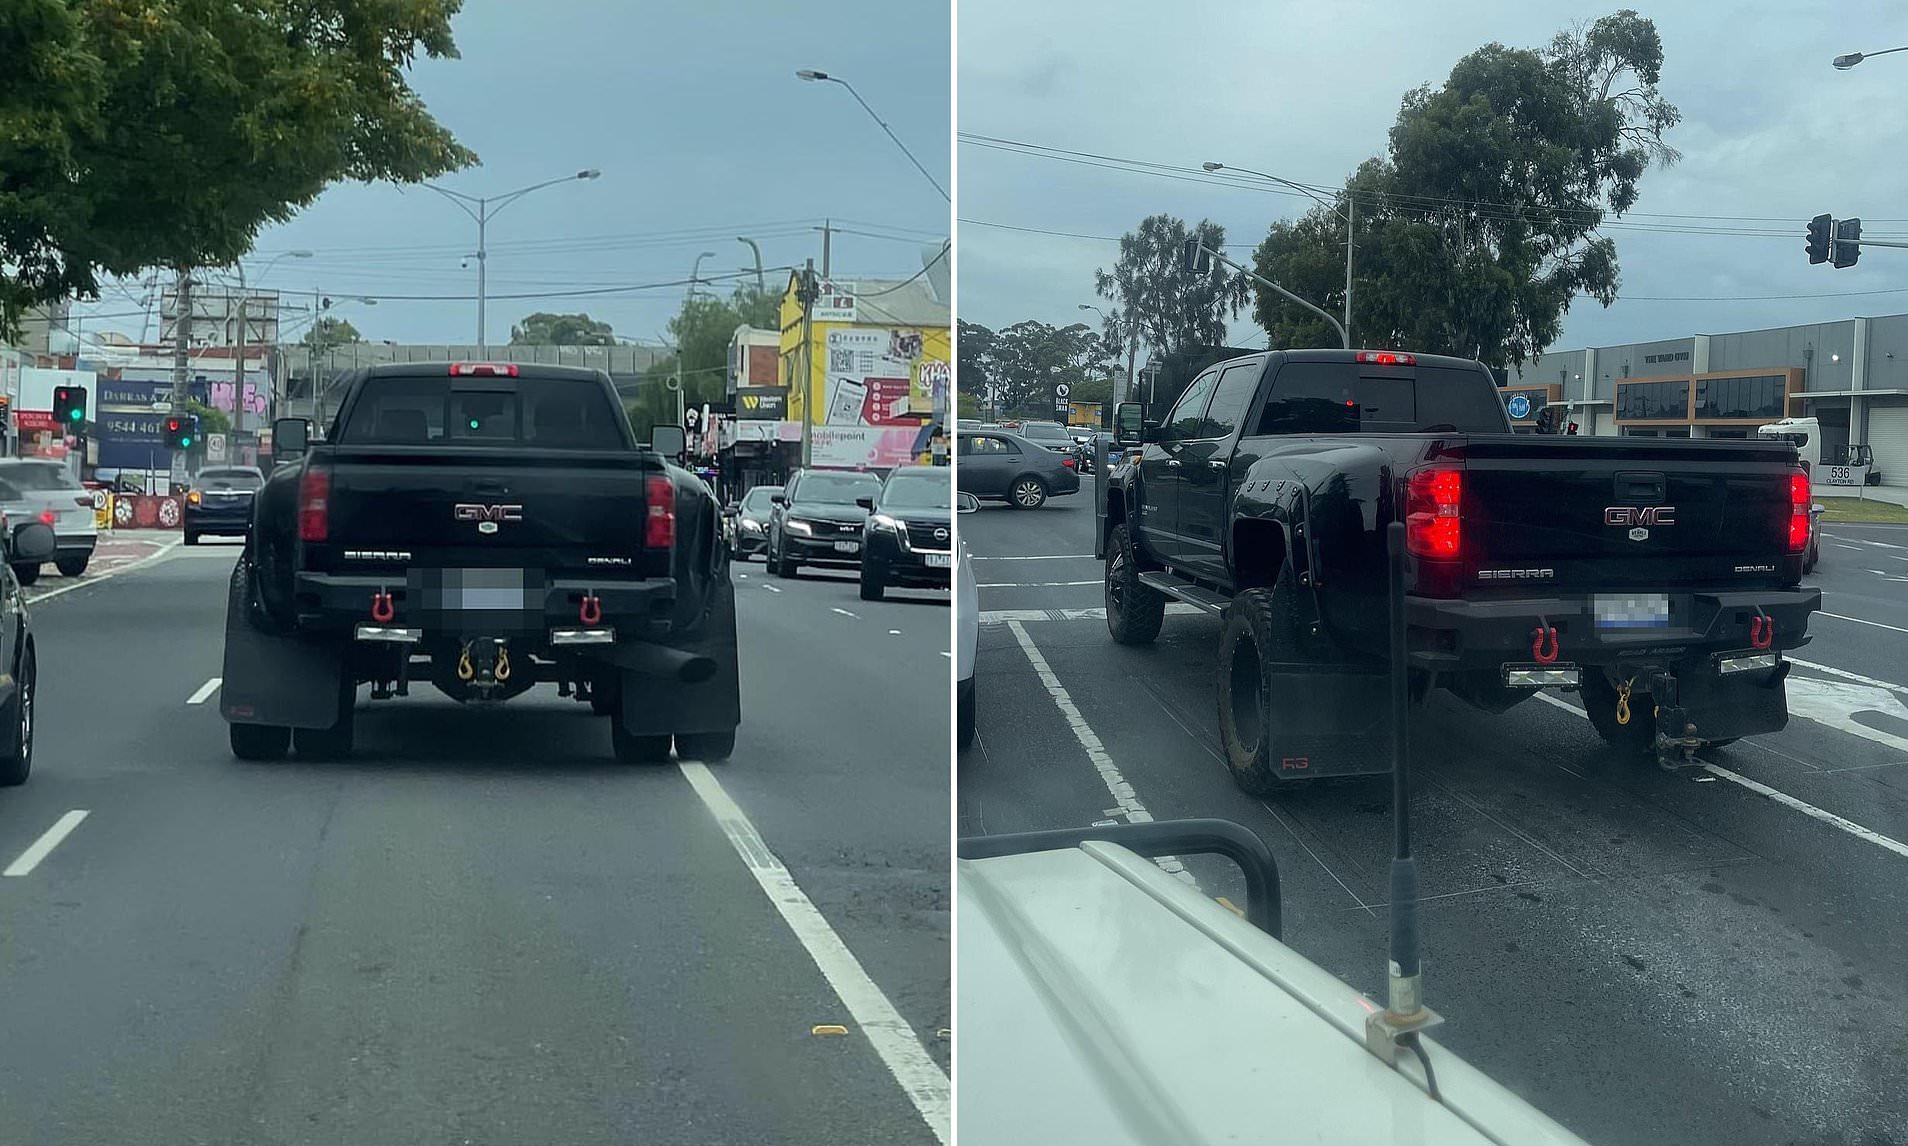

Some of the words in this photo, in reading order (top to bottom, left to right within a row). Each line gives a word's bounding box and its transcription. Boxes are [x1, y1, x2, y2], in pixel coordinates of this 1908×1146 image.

[107, 421, 136, 433] 9544
[140, 421, 160, 433] 461
[1831, 467, 1849, 478] 536
[455, 504, 522, 521] GMC
[1605, 507, 1675, 526] GMC
[344, 551, 411, 560] SIERRA
[1478, 569, 1554, 579] SIERRA
